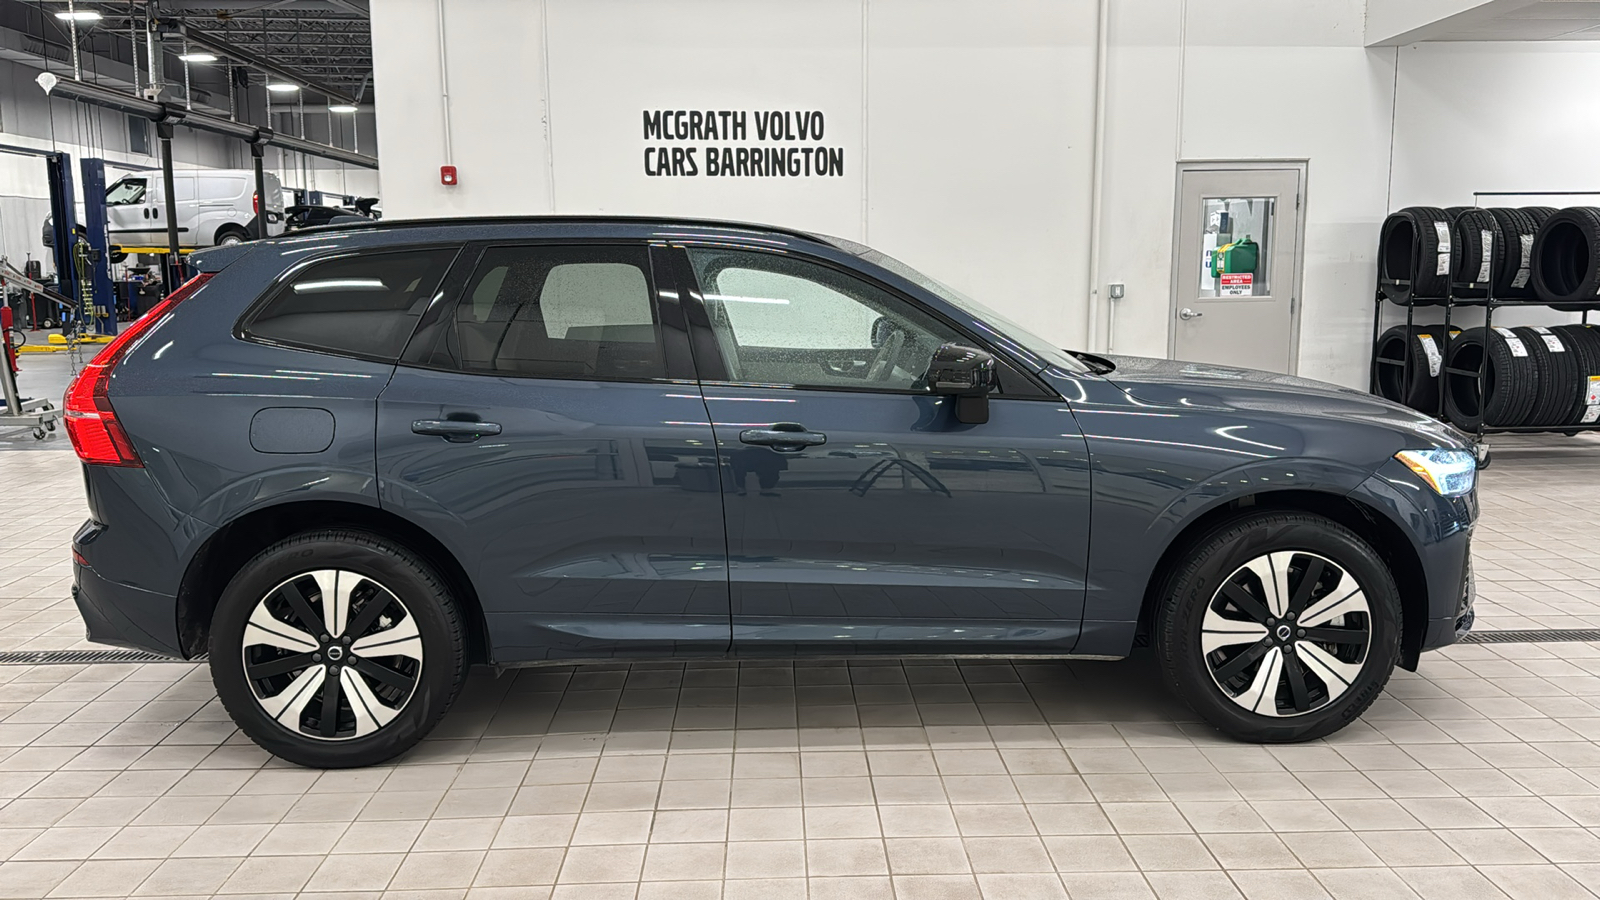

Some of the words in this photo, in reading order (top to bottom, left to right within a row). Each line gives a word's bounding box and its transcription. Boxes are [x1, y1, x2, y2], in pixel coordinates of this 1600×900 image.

[643, 110, 746, 140] MCGRATH
[754, 111, 824, 140] VOLVO
[644, 147, 698, 176] CARS
[706, 147, 843, 176] BARRINGTON
